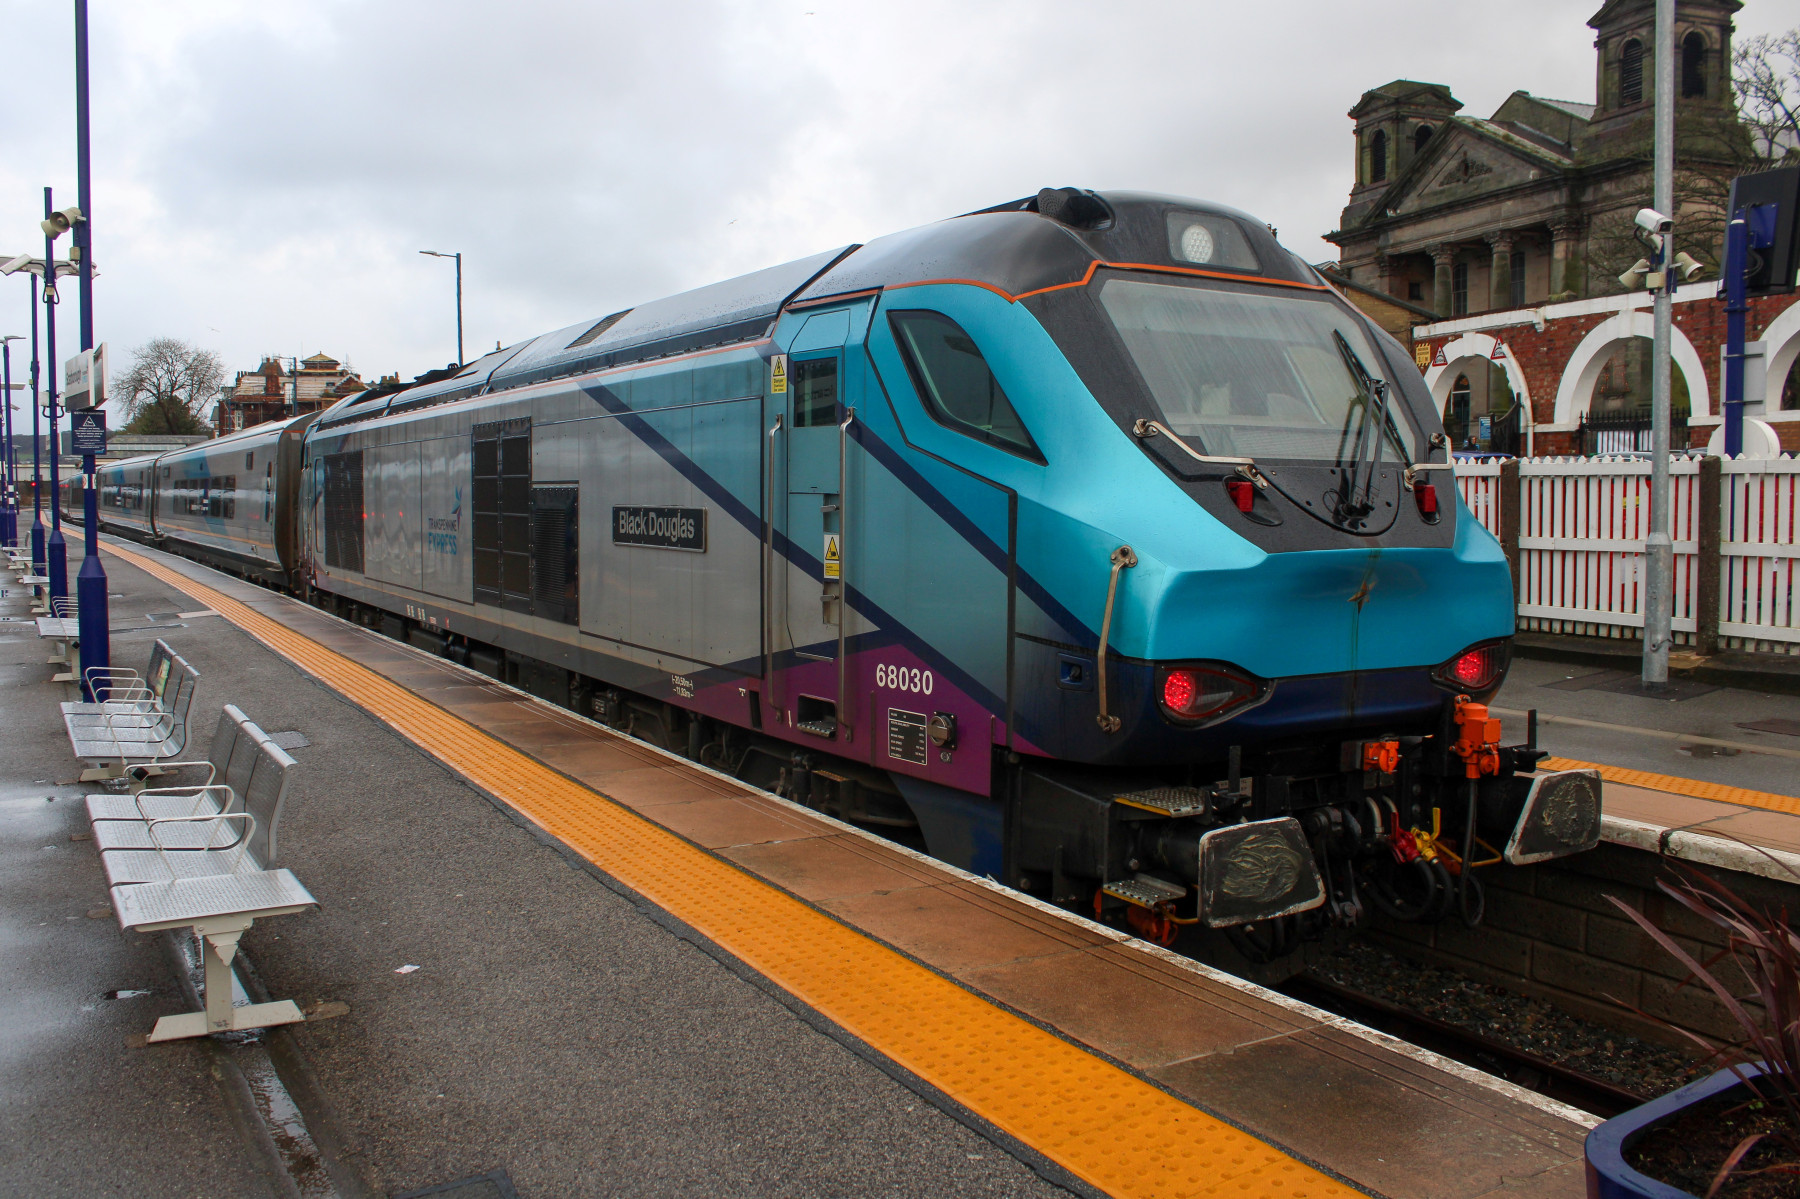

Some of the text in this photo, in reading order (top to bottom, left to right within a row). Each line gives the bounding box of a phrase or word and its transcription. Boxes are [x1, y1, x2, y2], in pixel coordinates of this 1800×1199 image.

[428, 517, 457, 532] TRANSPENNINE
[619, 511, 695, 543] Black Douglas
[428, 532, 457, 556] EXPRESS
[877, 663, 933, 695] 68030
